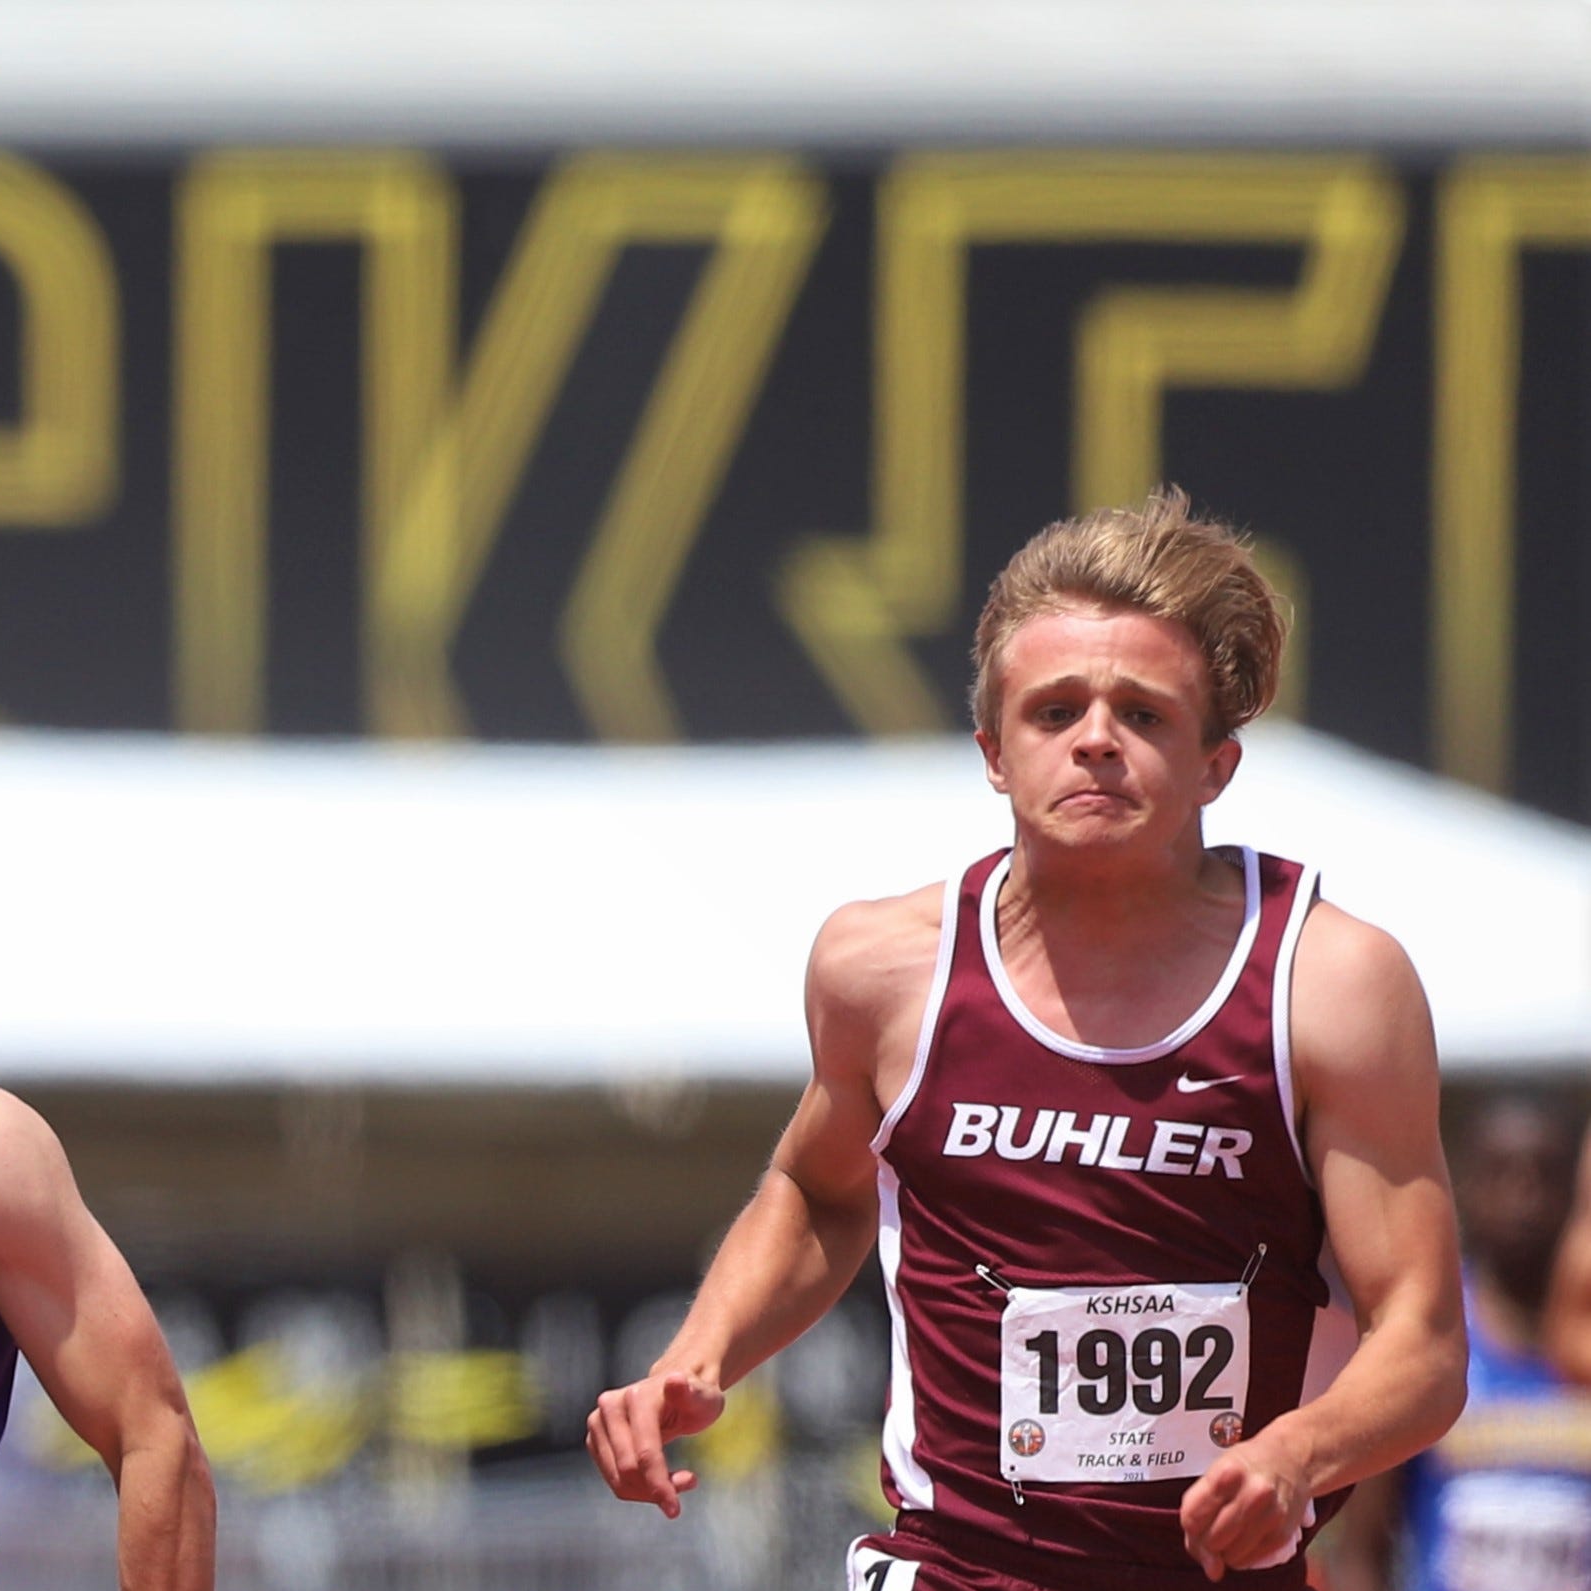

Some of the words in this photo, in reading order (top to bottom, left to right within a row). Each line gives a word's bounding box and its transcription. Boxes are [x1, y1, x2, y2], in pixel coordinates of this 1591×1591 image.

[942, 1102, 1254, 1180] BUHLER
[1085, 1293, 1175, 1315] KSHSAA
[1025, 1324, 1235, 1417] 1992
[1108, 1431, 1156, 1446] STATE
[1077, 1453, 1125, 1467] TRACK
[1129, 1453, 1142, 1467] &
[1147, 1450, 1186, 1466] FIELD
[1122, 1471, 1145, 1481] 2021
